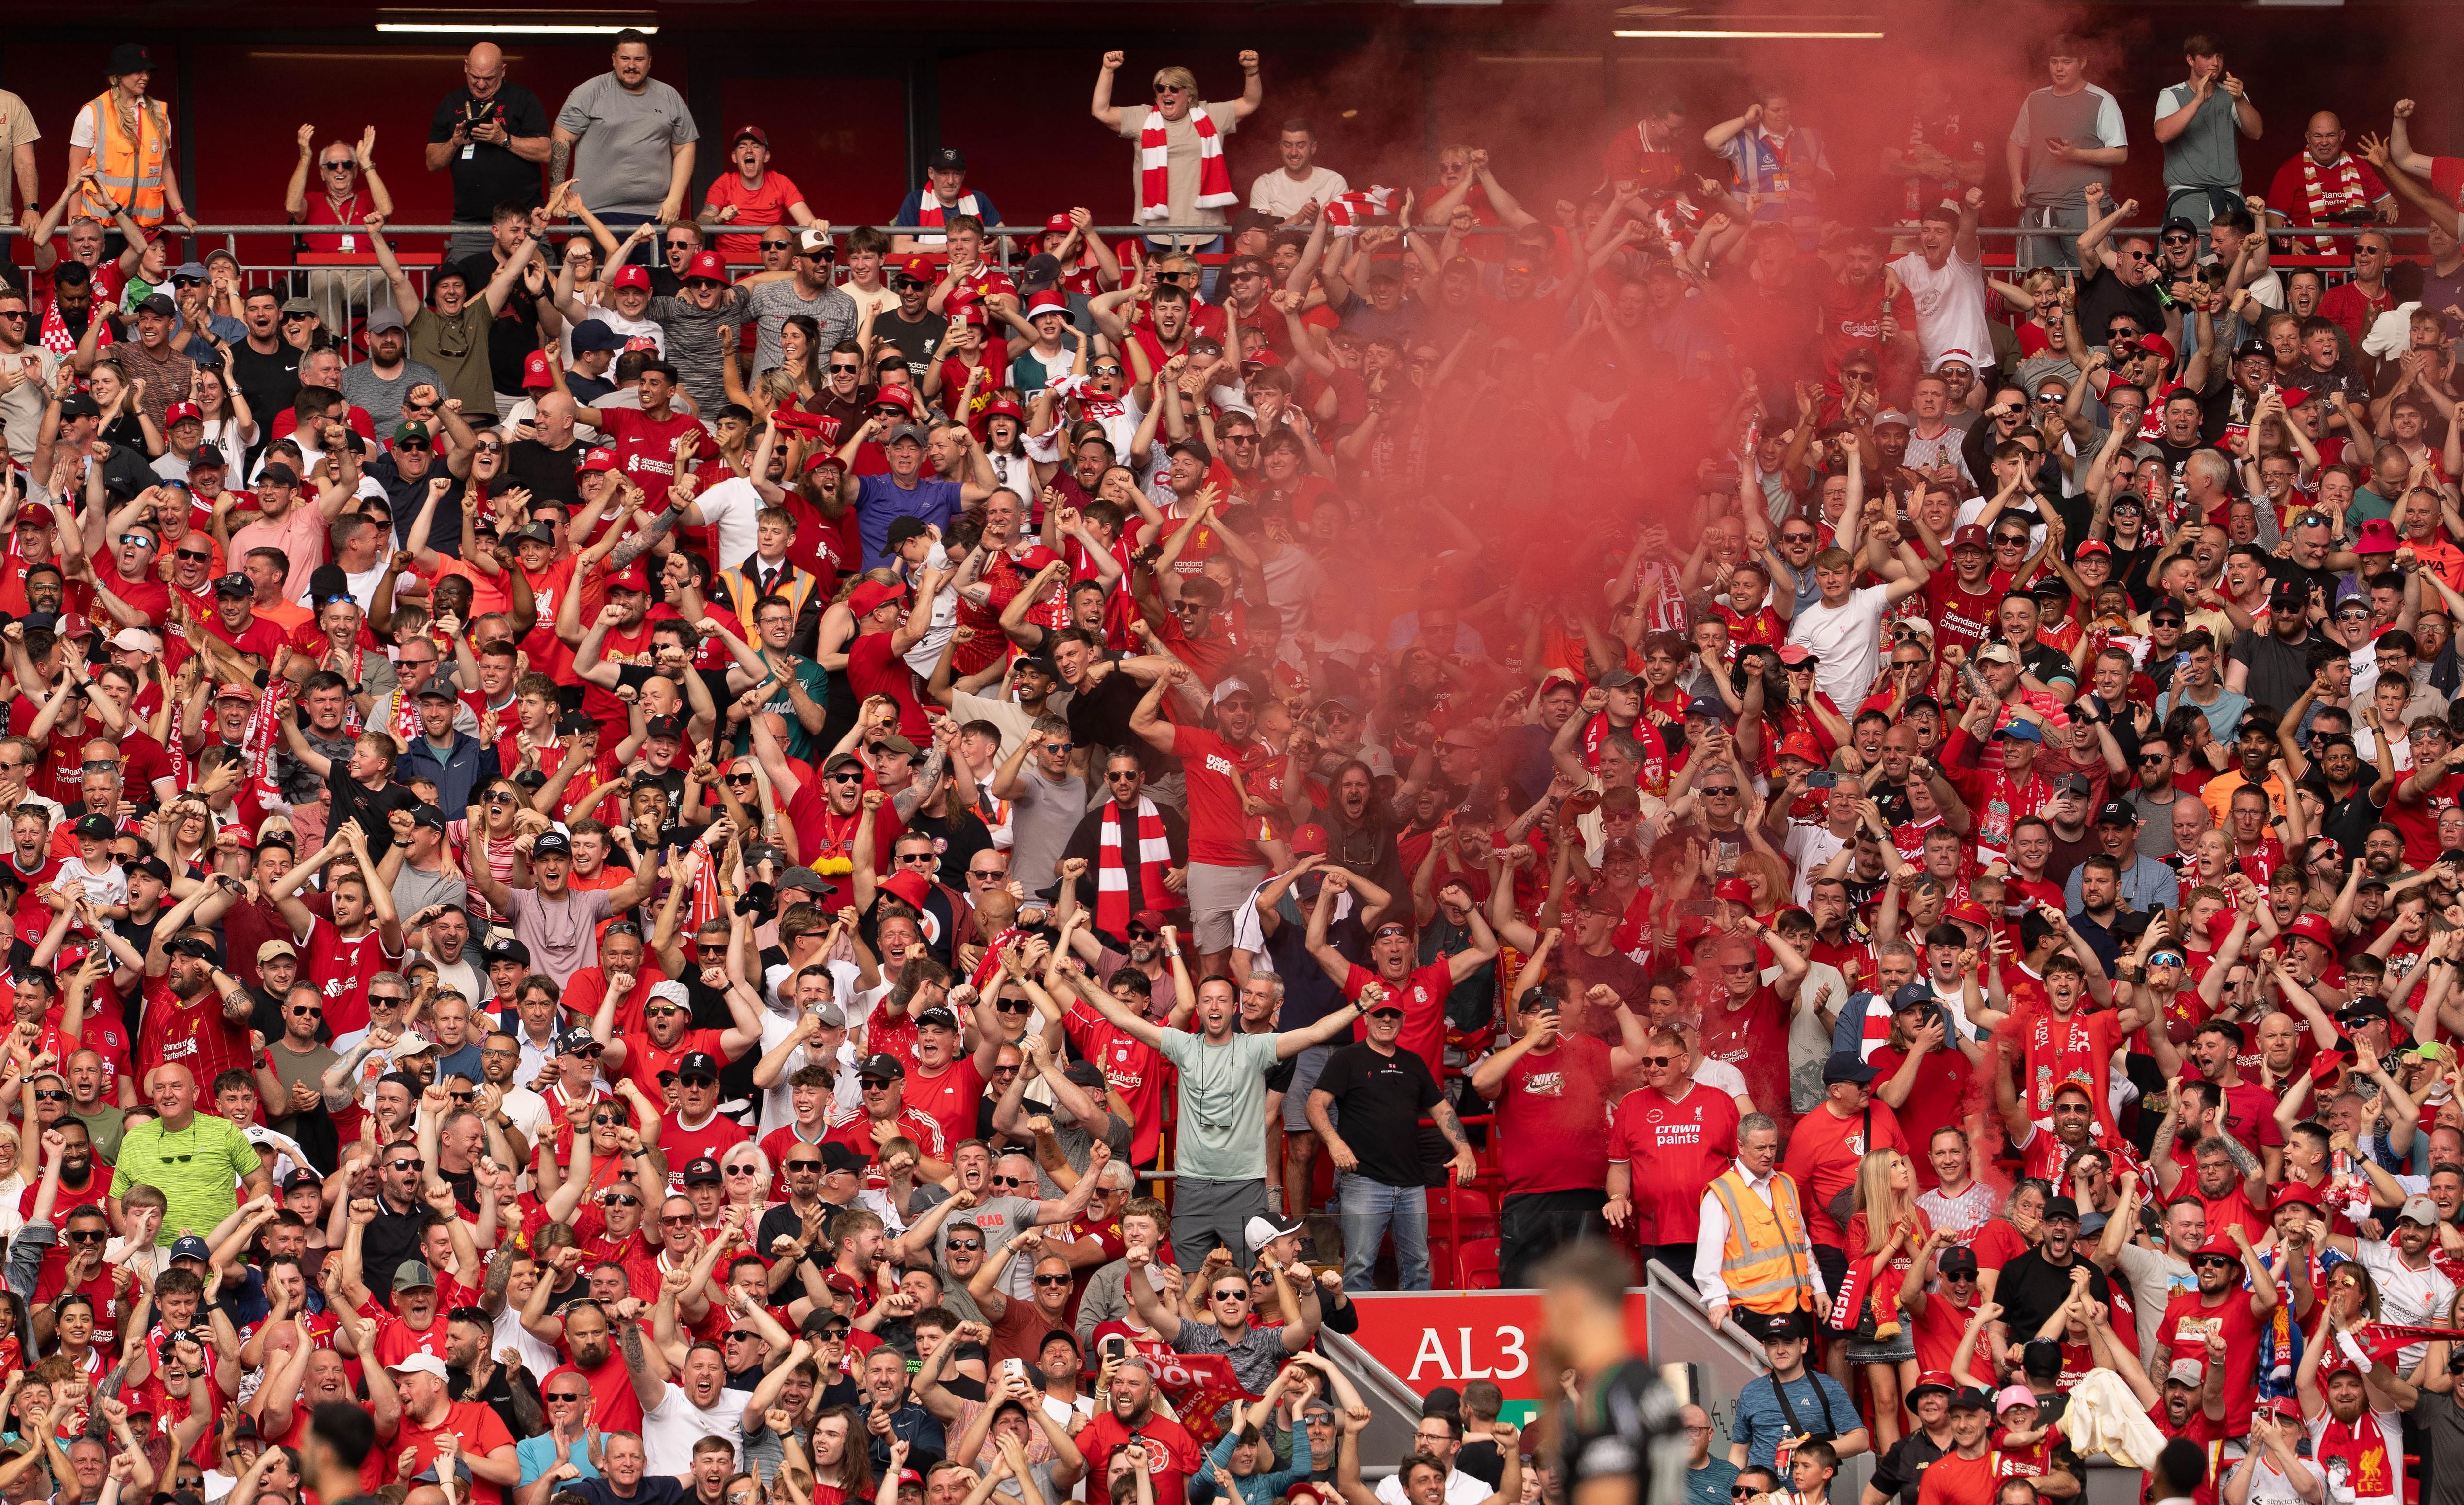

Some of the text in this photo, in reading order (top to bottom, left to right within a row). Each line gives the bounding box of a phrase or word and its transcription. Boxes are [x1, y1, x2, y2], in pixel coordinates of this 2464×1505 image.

[2255, 341, 2263, 350] LA
[640, 457, 673, 470] standard
[640, 465, 674, 476] chartered
[1944, 611, 1982, 630] Standard
[1940, 619, 1979, 638] Chartered
[1229, 681, 1239, 689] NY
[2068, 1023, 2076, 1052] ALONE
[163, 1038, 187, 1052] Standard
[1533, 1072, 1561, 1087] NIKE
[1655, 1124, 1701, 1134] crown
[1656, 1132, 1700, 1147] paints
[976, 1214, 1004, 1228] RAB
[174, 1330, 187, 1341] NY
[1406, 1325, 1529, 1381] AL3
